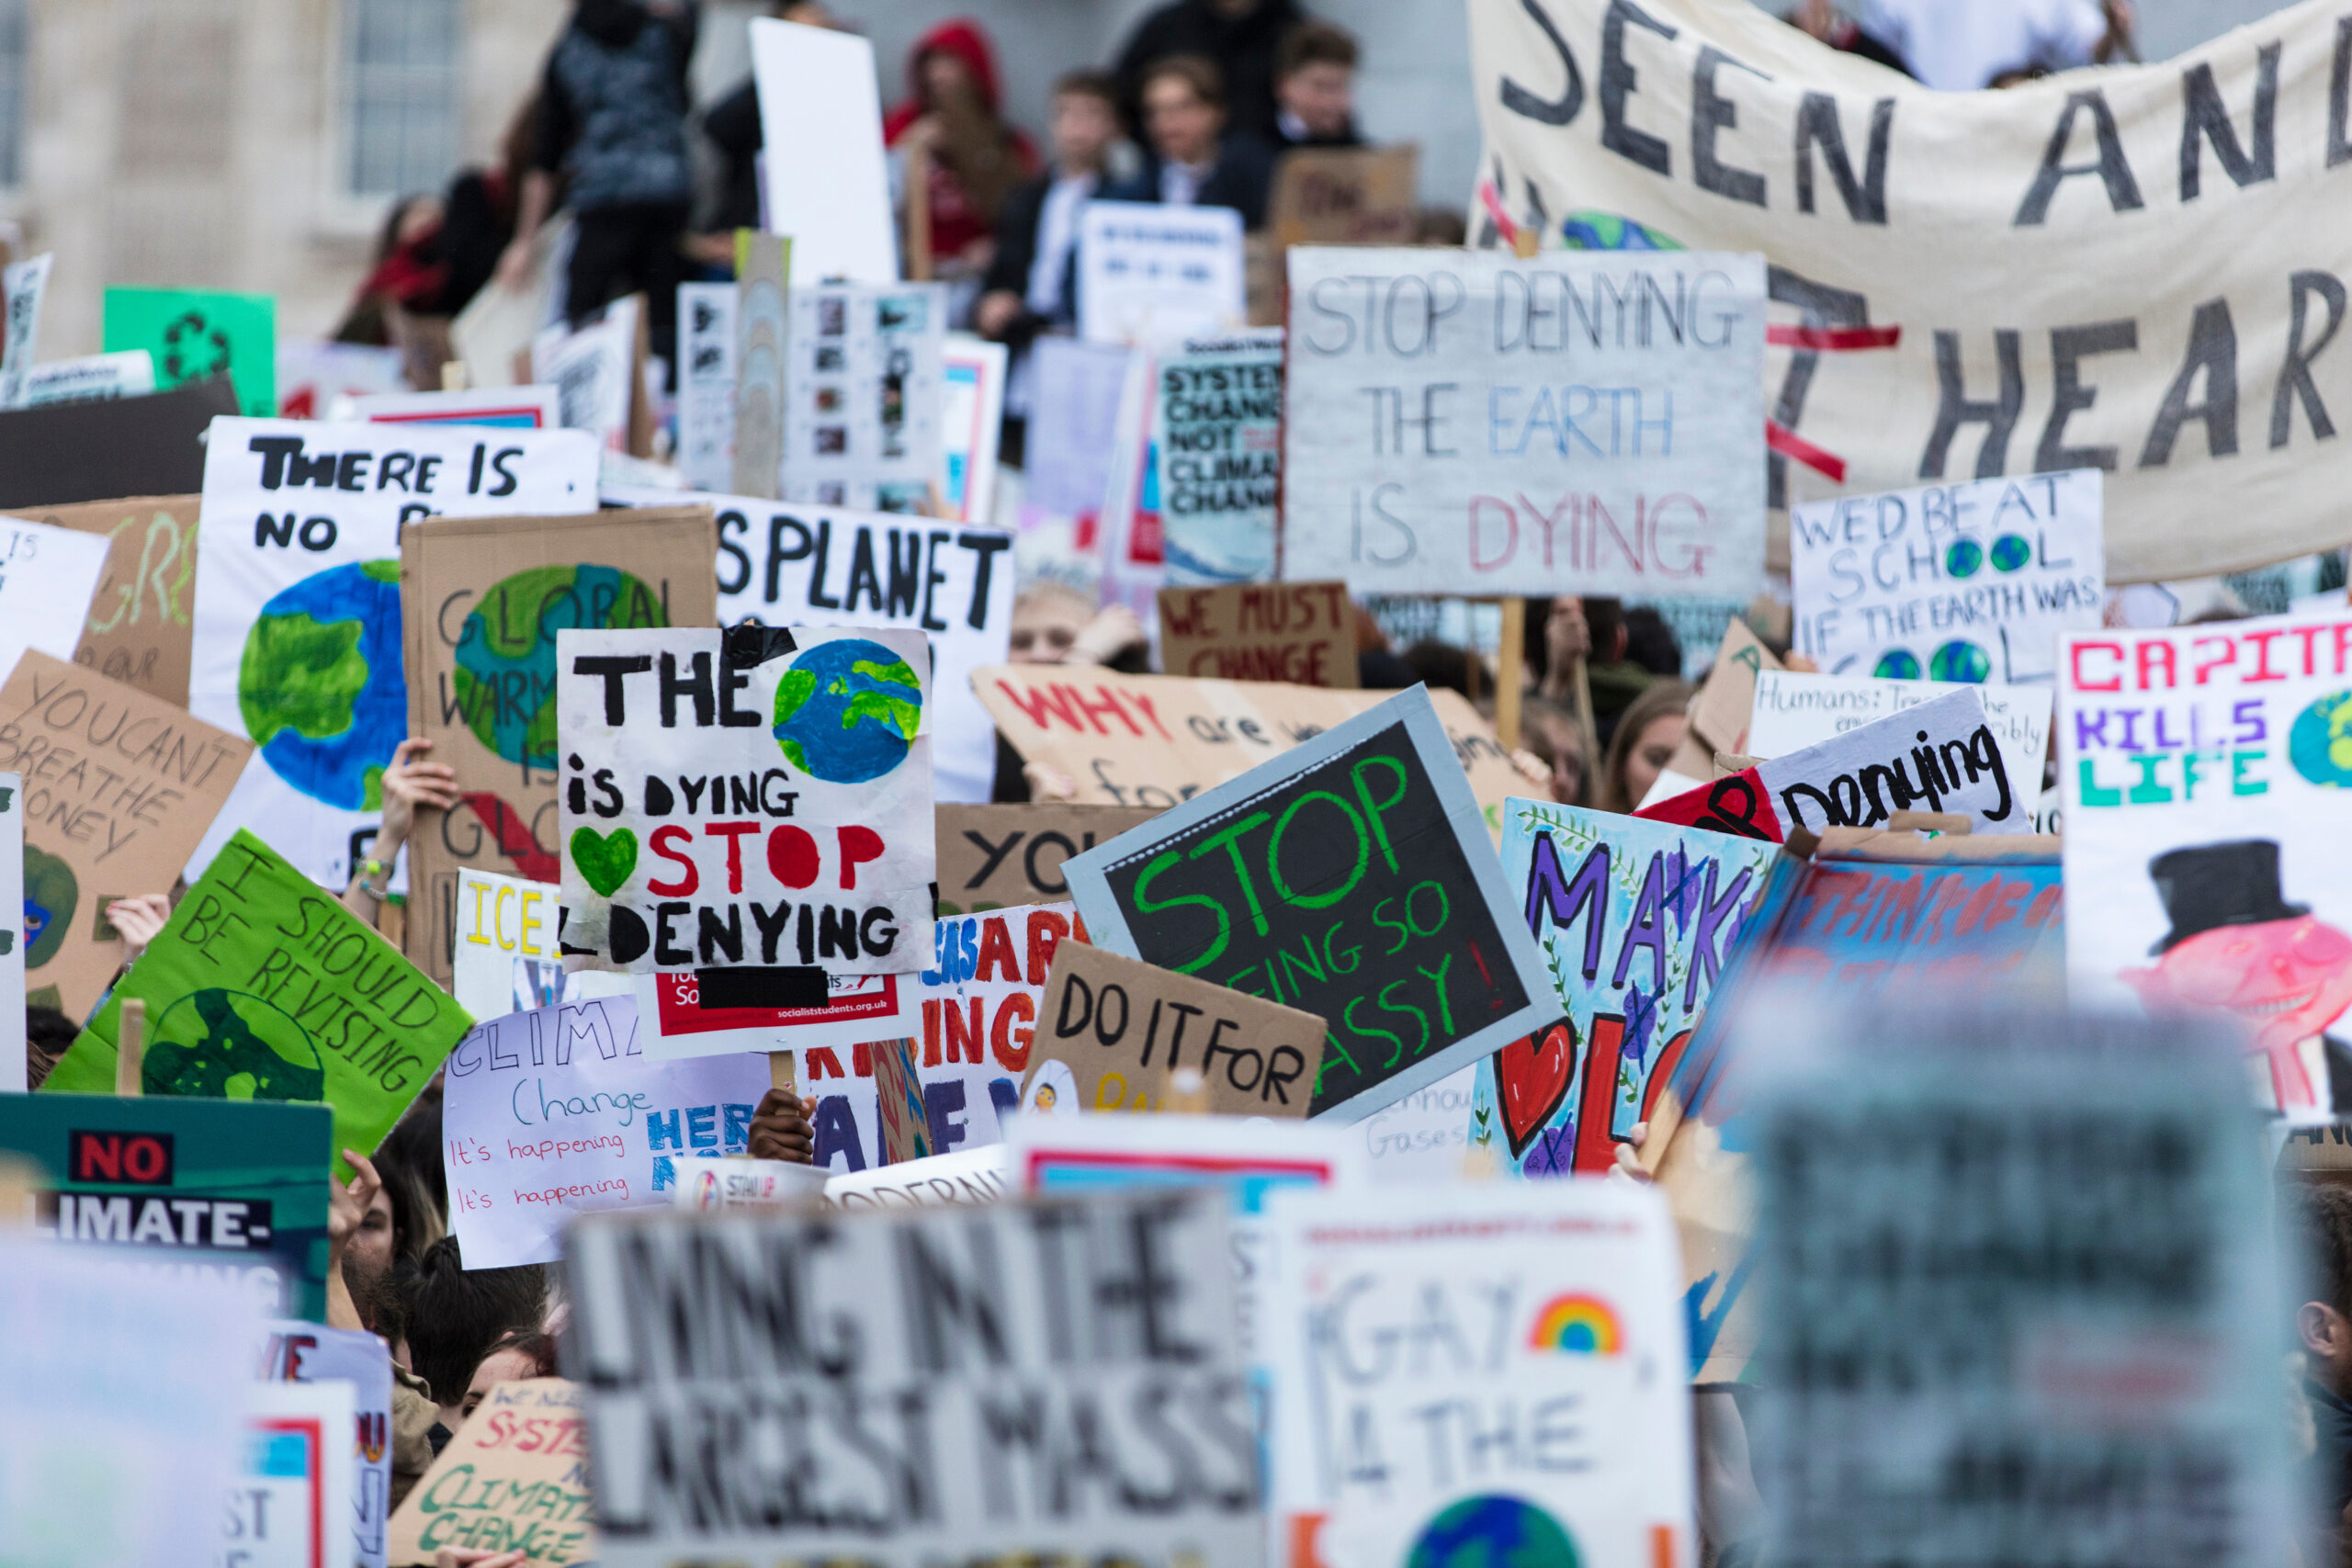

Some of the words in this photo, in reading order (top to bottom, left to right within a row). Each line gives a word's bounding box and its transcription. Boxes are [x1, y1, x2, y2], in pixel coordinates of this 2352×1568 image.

[1498, 0, 1899, 227] SEEN
[1301, 269, 1467, 359] STOP
[1493, 269, 1745, 354] DENYING
[1168, 425, 1233, 452] NOT
[1357, 381, 1460, 458] THE
[1487, 383, 1676, 459] EARTH
[249, 434, 443, 493] THERE
[468, 442, 526, 498] IS
[255, 511, 339, 551] NO
[1349, 482, 1419, 569] IS
[1469, 491, 1719, 580] DYING
[1921, 480, 1981, 536] BE
[1990, 471, 2073, 528] AT
[763, 514, 1011, 632] PLANET
[438, 579, 695, 648] GLOBAL
[1159, 590, 1220, 639] WE
[1238, 584, 1345, 636] MUST
[1802, 608, 1842, 657] IF
[1859, 599, 1925, 642] THE
[1929, 582, 2027, 628] EARTH
[2030, 574, 2101, 611] WAS
[572, 649, 764, 729] THE
[1188, 640, 1332, 687] CHANGE
[1756, 671, 1883, 713] Humans:
[13, 671, 130, 747] YOU
[995, 676, 1174, 744] WHY
[1186, 714, 1272, 746] are
[2075, 699, 2267, 752] KILLS
[0, 721, 185, 829] BREATHE
[567, 752, 625, 818] is
[644, 768, 799, 818] DYING
[1780, 723, 2012, 829] Denying
[2078, 750, 2269, 807] LIFE
[22, 779, 139, 864] ONEY
[647, 821, 886, 897] STOP
[1134, 754, 1408, 974] STOP
[215, 842, 274, 904] I
[276, 896, 439, 1030] SHOULD
[467, 881, 542, 954] ICE
[608, 897, 901, 965] DENYING
[1372, 880, 1450, 955] SO
[1523, 829, 1754, 1014] MAK
[178, 894, 252, 965] BE
[245, 946, 424, 1094] REVISING
[777, 998, 888, 1019] socialiststudents.org.uk
[1055, 972, 1130, 1047] DO
[1139, 998, 1204, 1072] IT
[1203, 1018, 1306, 1105] FOR
[512, 1077, 653, 1127] Change
[1365, 1114, 1468, 1159] Gases
[79, 1134, 167, 1182] NO
[449, 1137, 492, 1167] It's
[507, 1134, 625, 1162] happening
[458, 1188, 493, 1213] It's
[514, 1177, 629, 1206] happening
[1335, 1269, 1525, 1387] GAY
[1409, 1391, 1597, 1490] THE
[419, 1511, 586, 1563] CHANGE
